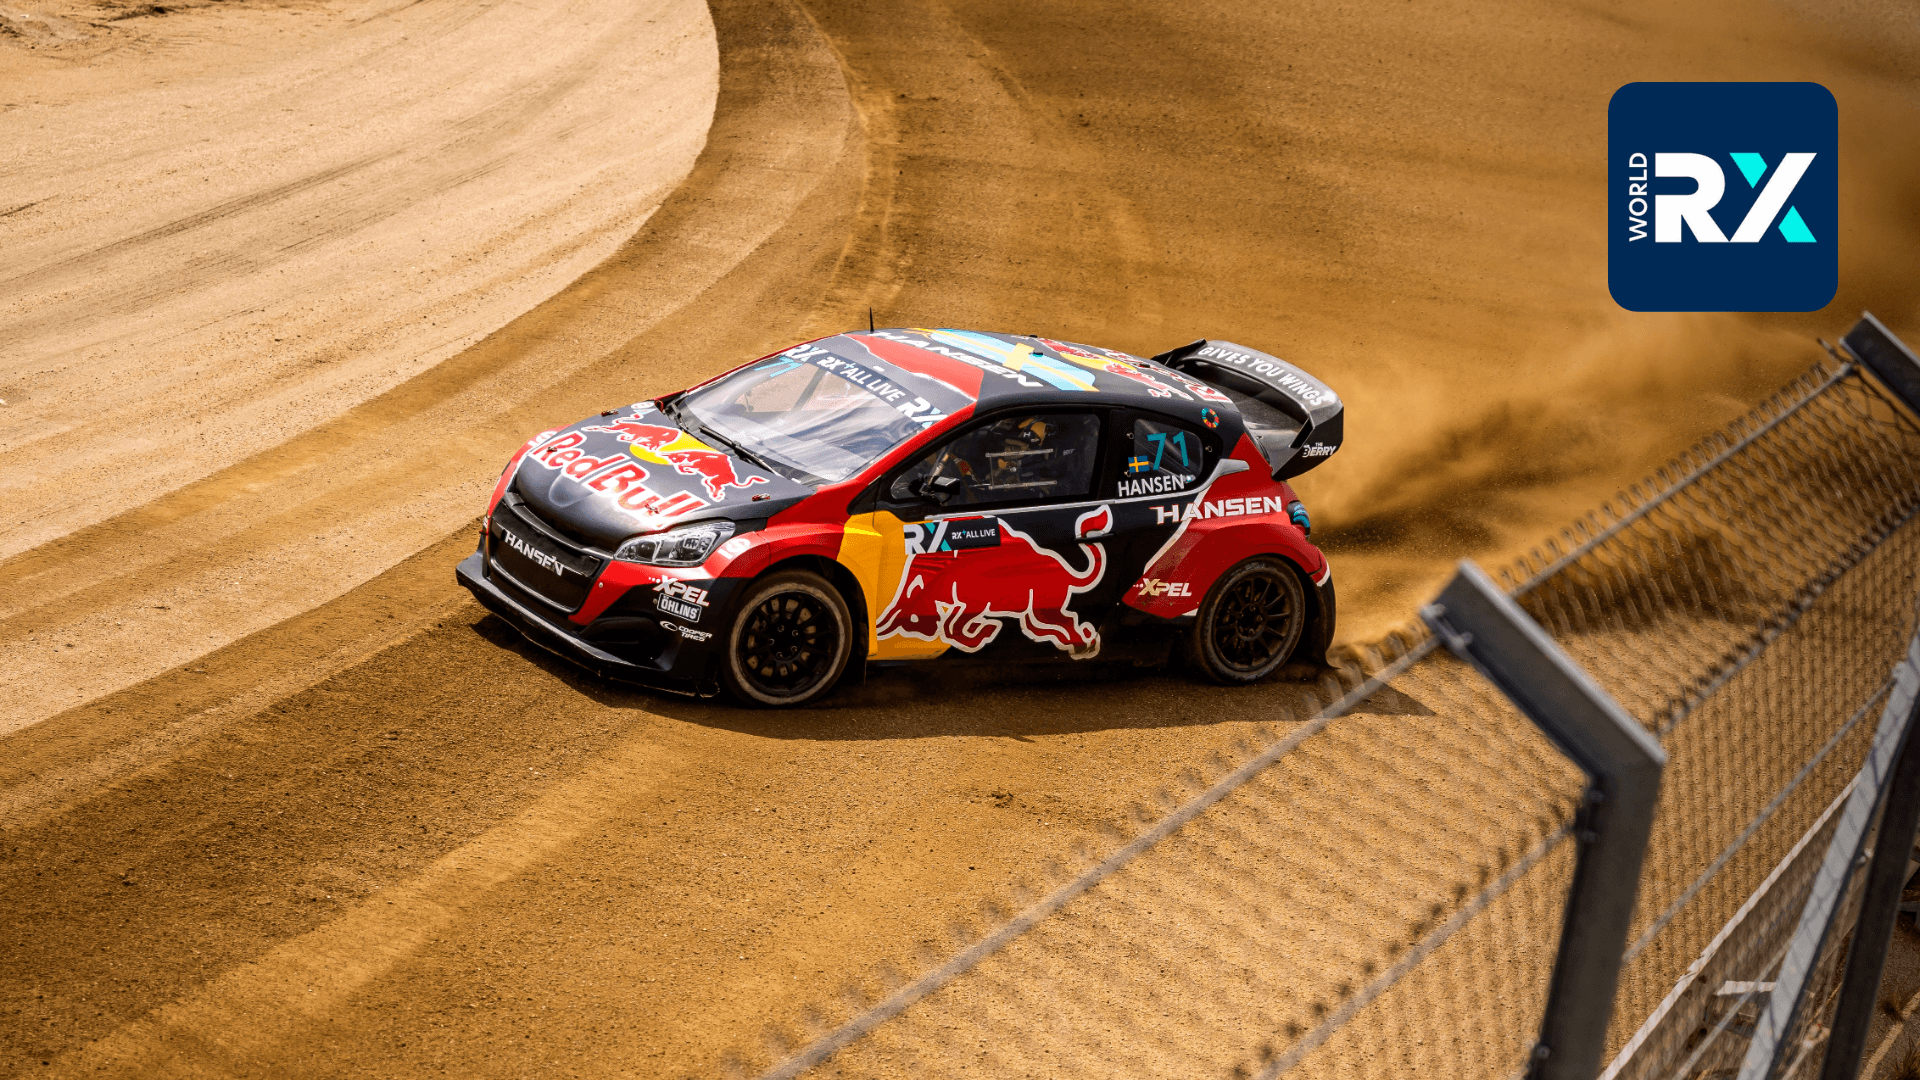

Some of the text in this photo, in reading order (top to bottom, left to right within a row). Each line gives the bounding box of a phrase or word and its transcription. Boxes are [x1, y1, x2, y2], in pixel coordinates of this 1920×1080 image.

[865, 378, 906, 402] LIVE
[1197, 346, 1325, 406] GIVES YOU WINGS
[896, 396, 949, 429] RX
[1147, 431, 1189, 470] 71
[527, 430, 711, 530] Red Bull
[1117, 474, 1185, 497] HANSEN
[1149, 496, 1283, 525] HANSEN
[903, 520, 952, 555] RX
[980, 528, 996, 538] LIVE
[504, 529, 564, 577] HANSEN
[652, 575, 710, 607] XPEL
[1138, 578, 1192, 597] XPEL
[660, 595, 698, 620] ÖHLINS
[678, 625, 713, 638] COOPER
[681, 631, 706, 642] TIRES
